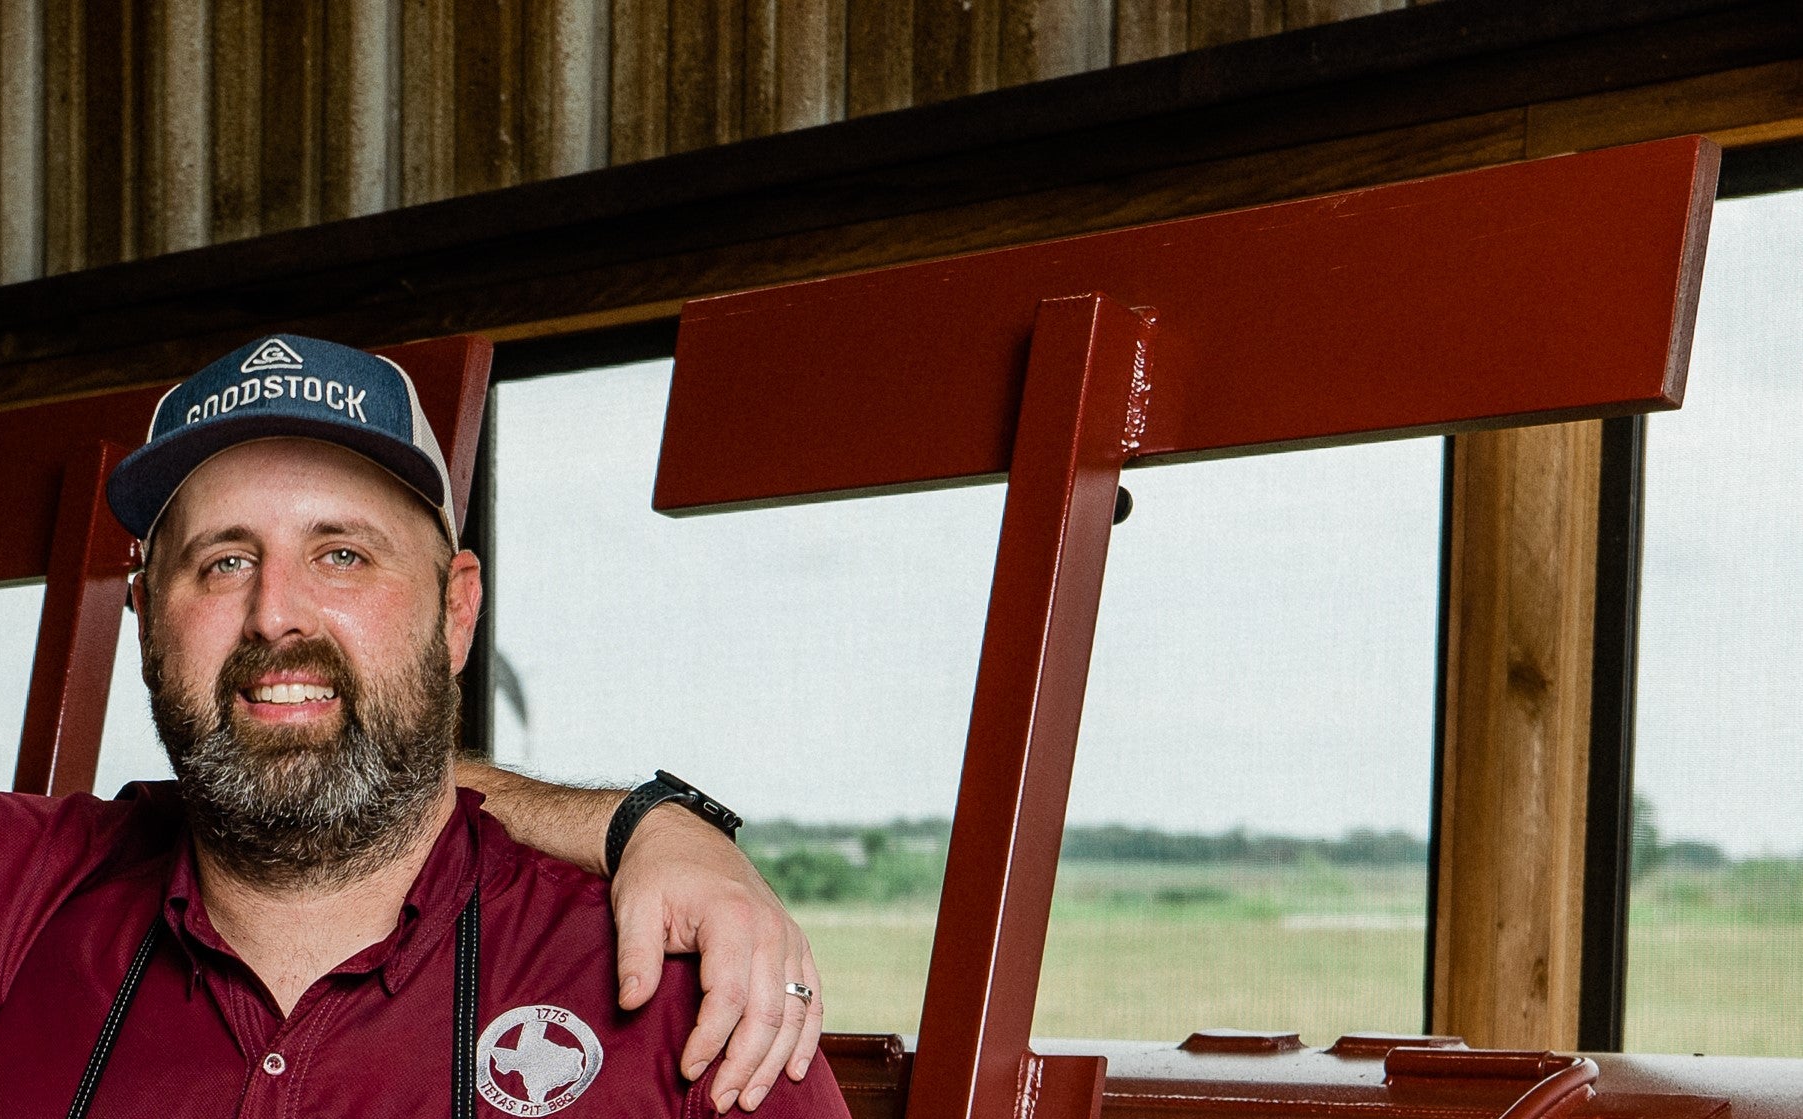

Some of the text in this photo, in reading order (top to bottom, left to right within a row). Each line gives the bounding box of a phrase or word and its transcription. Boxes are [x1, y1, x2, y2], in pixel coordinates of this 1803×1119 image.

[186, 375, 367, 424] GOODSTOCK
[535, 1008, 569, 1023] 1775
[480, 1081, 574, 1115] TEXAS PIT BBQ
